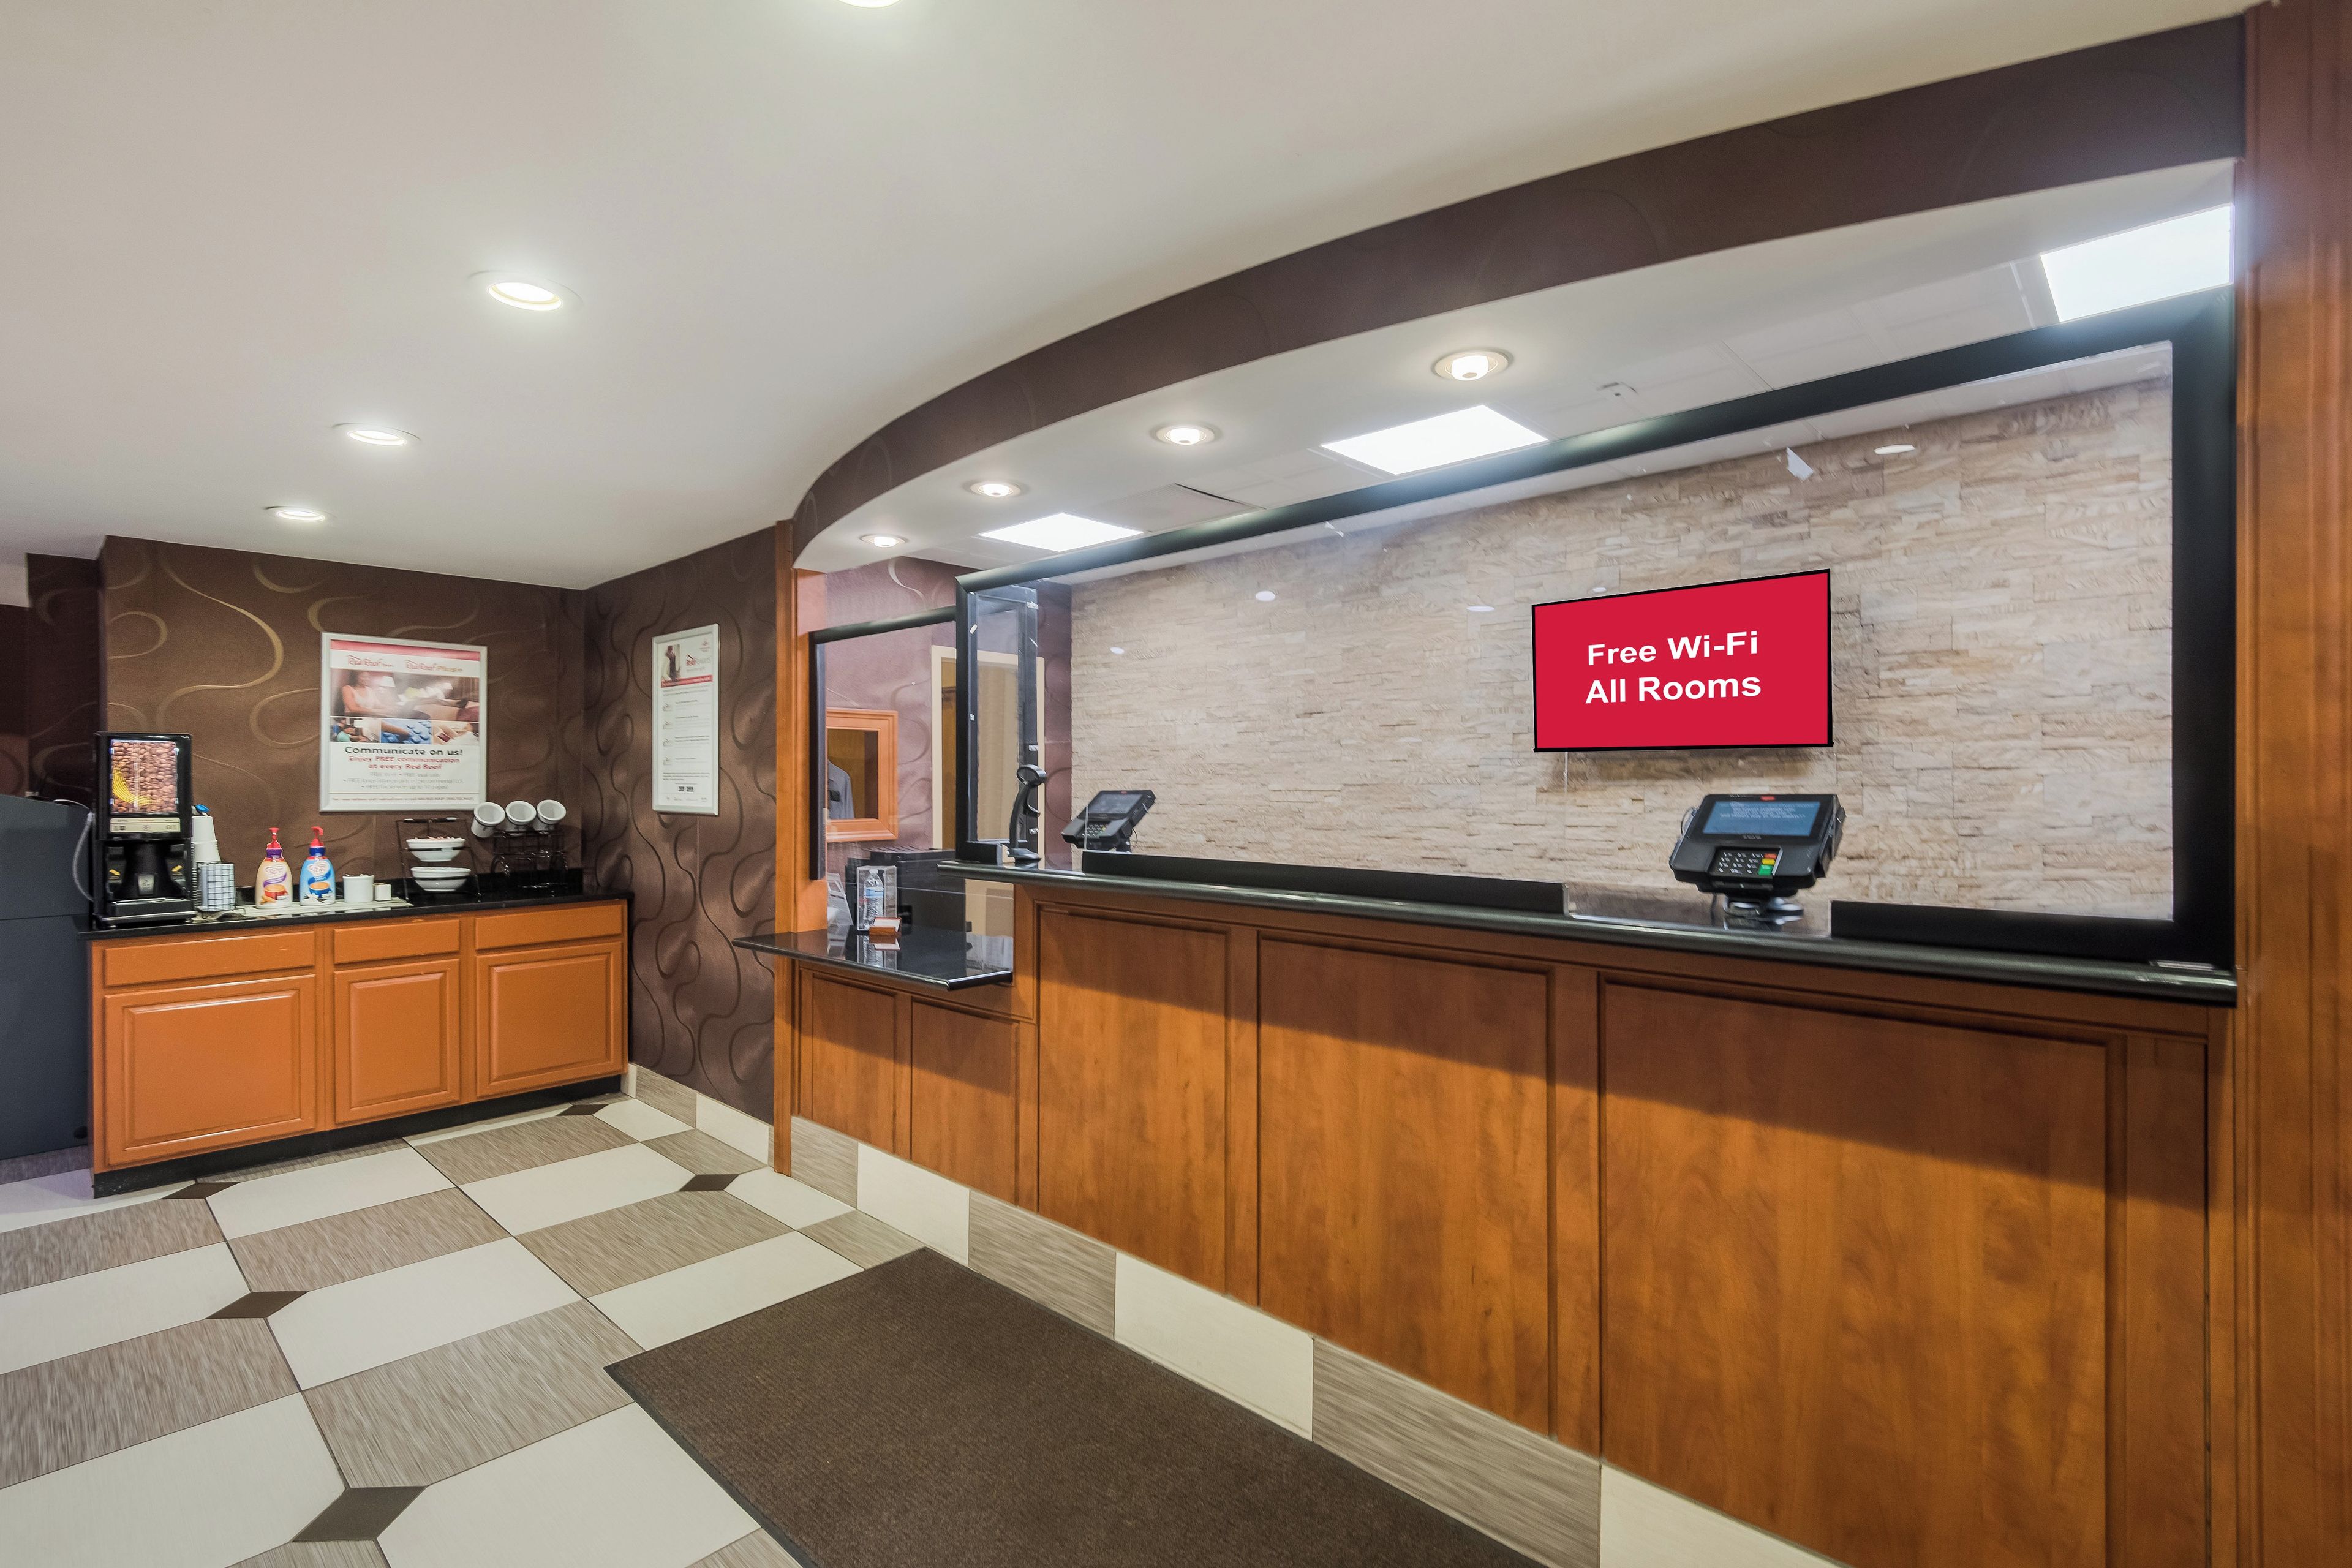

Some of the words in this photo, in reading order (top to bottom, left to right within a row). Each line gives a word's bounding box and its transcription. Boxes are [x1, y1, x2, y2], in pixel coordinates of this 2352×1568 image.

[1588, 644, 1656, 666] Free
[1667, 631, 1757, 660] Wi-Fi
[1585, 679, 1626, 704] All
[1638, 677, 1761, 701] Rooms
[345, 746, 426, 755] Communicate
